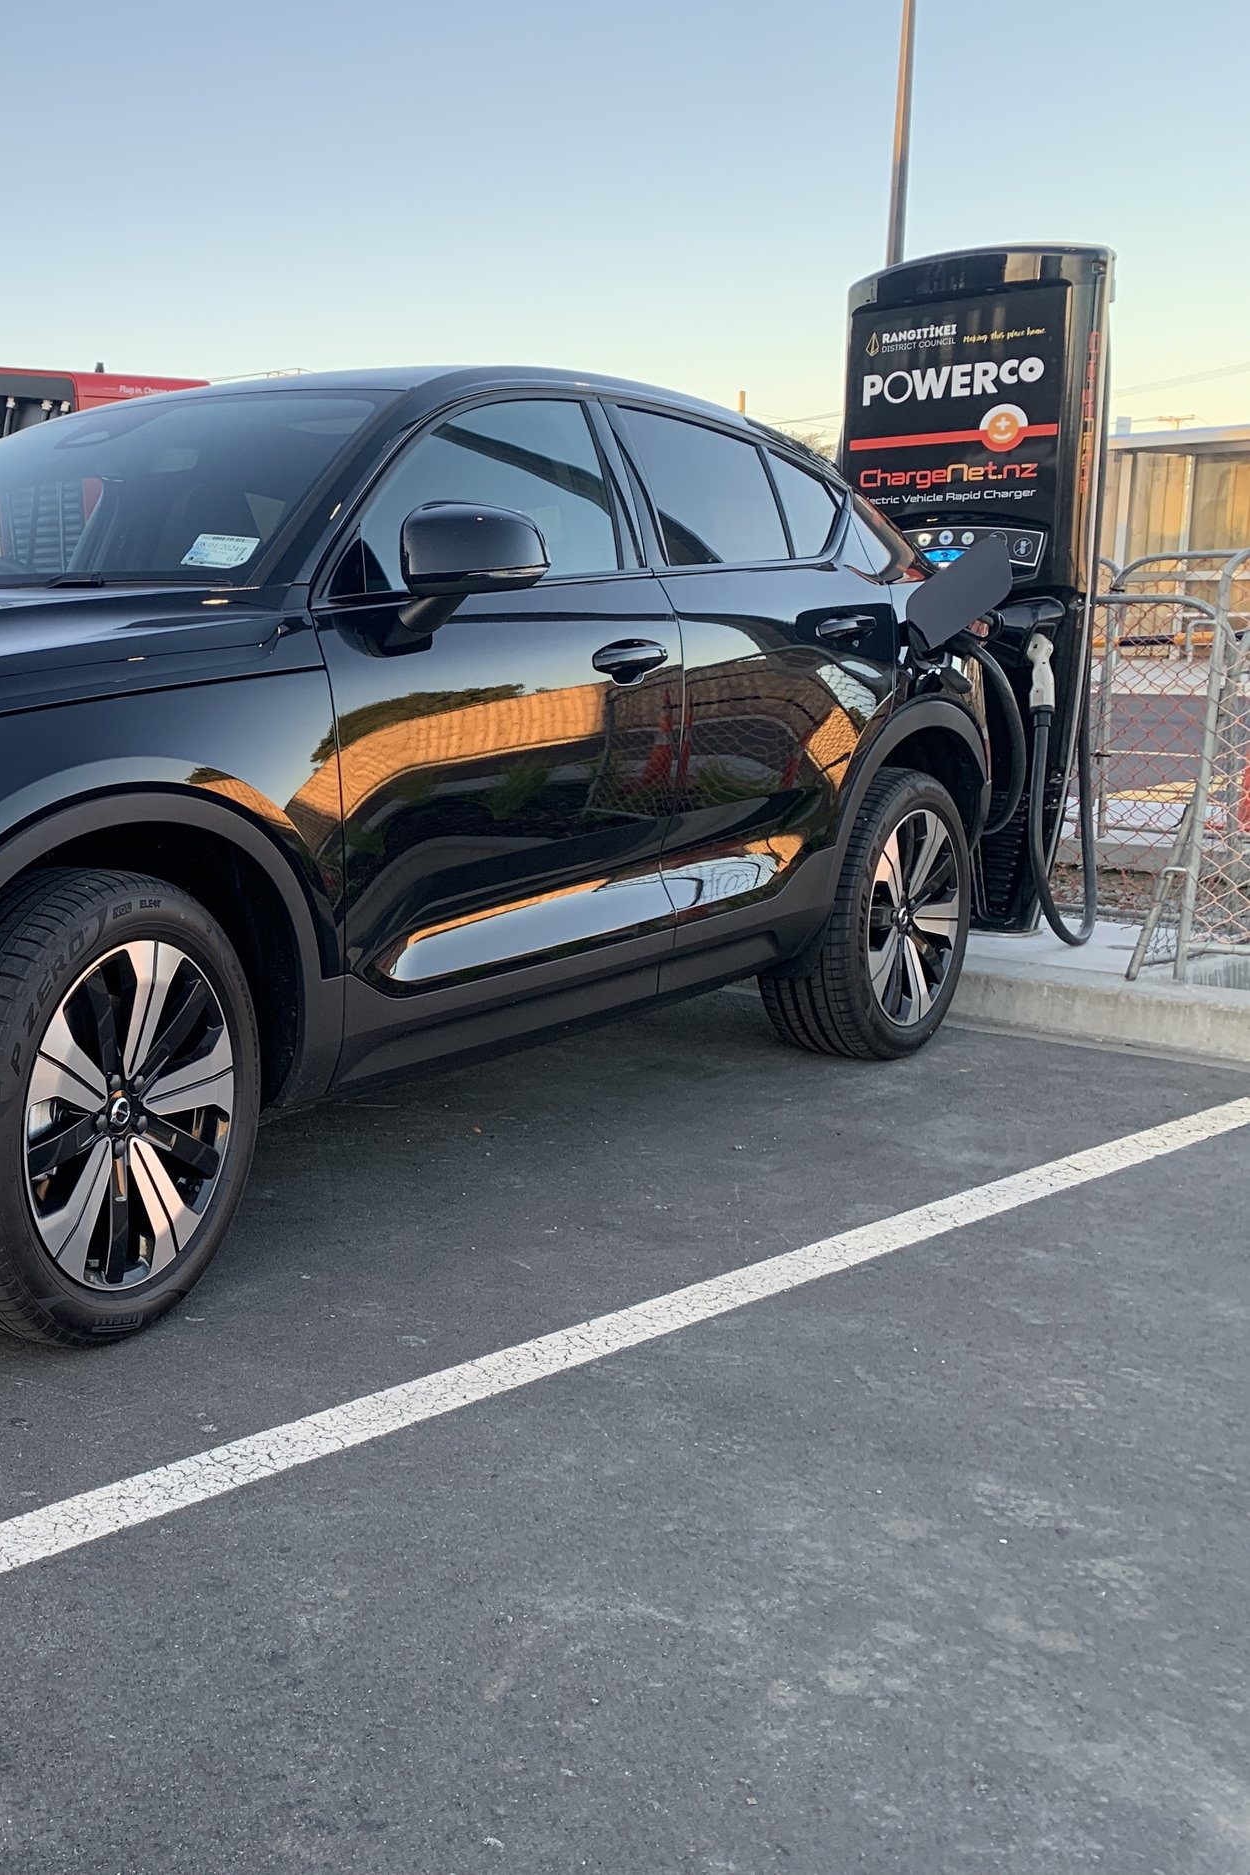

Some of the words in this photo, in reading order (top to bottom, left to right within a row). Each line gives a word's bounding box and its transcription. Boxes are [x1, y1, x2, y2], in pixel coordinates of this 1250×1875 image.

[881, 341, 917, 354] DISTRICT
[918, 337, 957, 349] COUNCIL
[862, 356, 1045, 406] POWERCO
[859, 460, 1038, 489] ChargeNet.nz
[902, 492, 944, 504] Vehicle
[945, 490, 981, 503] Rapid
[983, 488, 1037, 501] Charger
